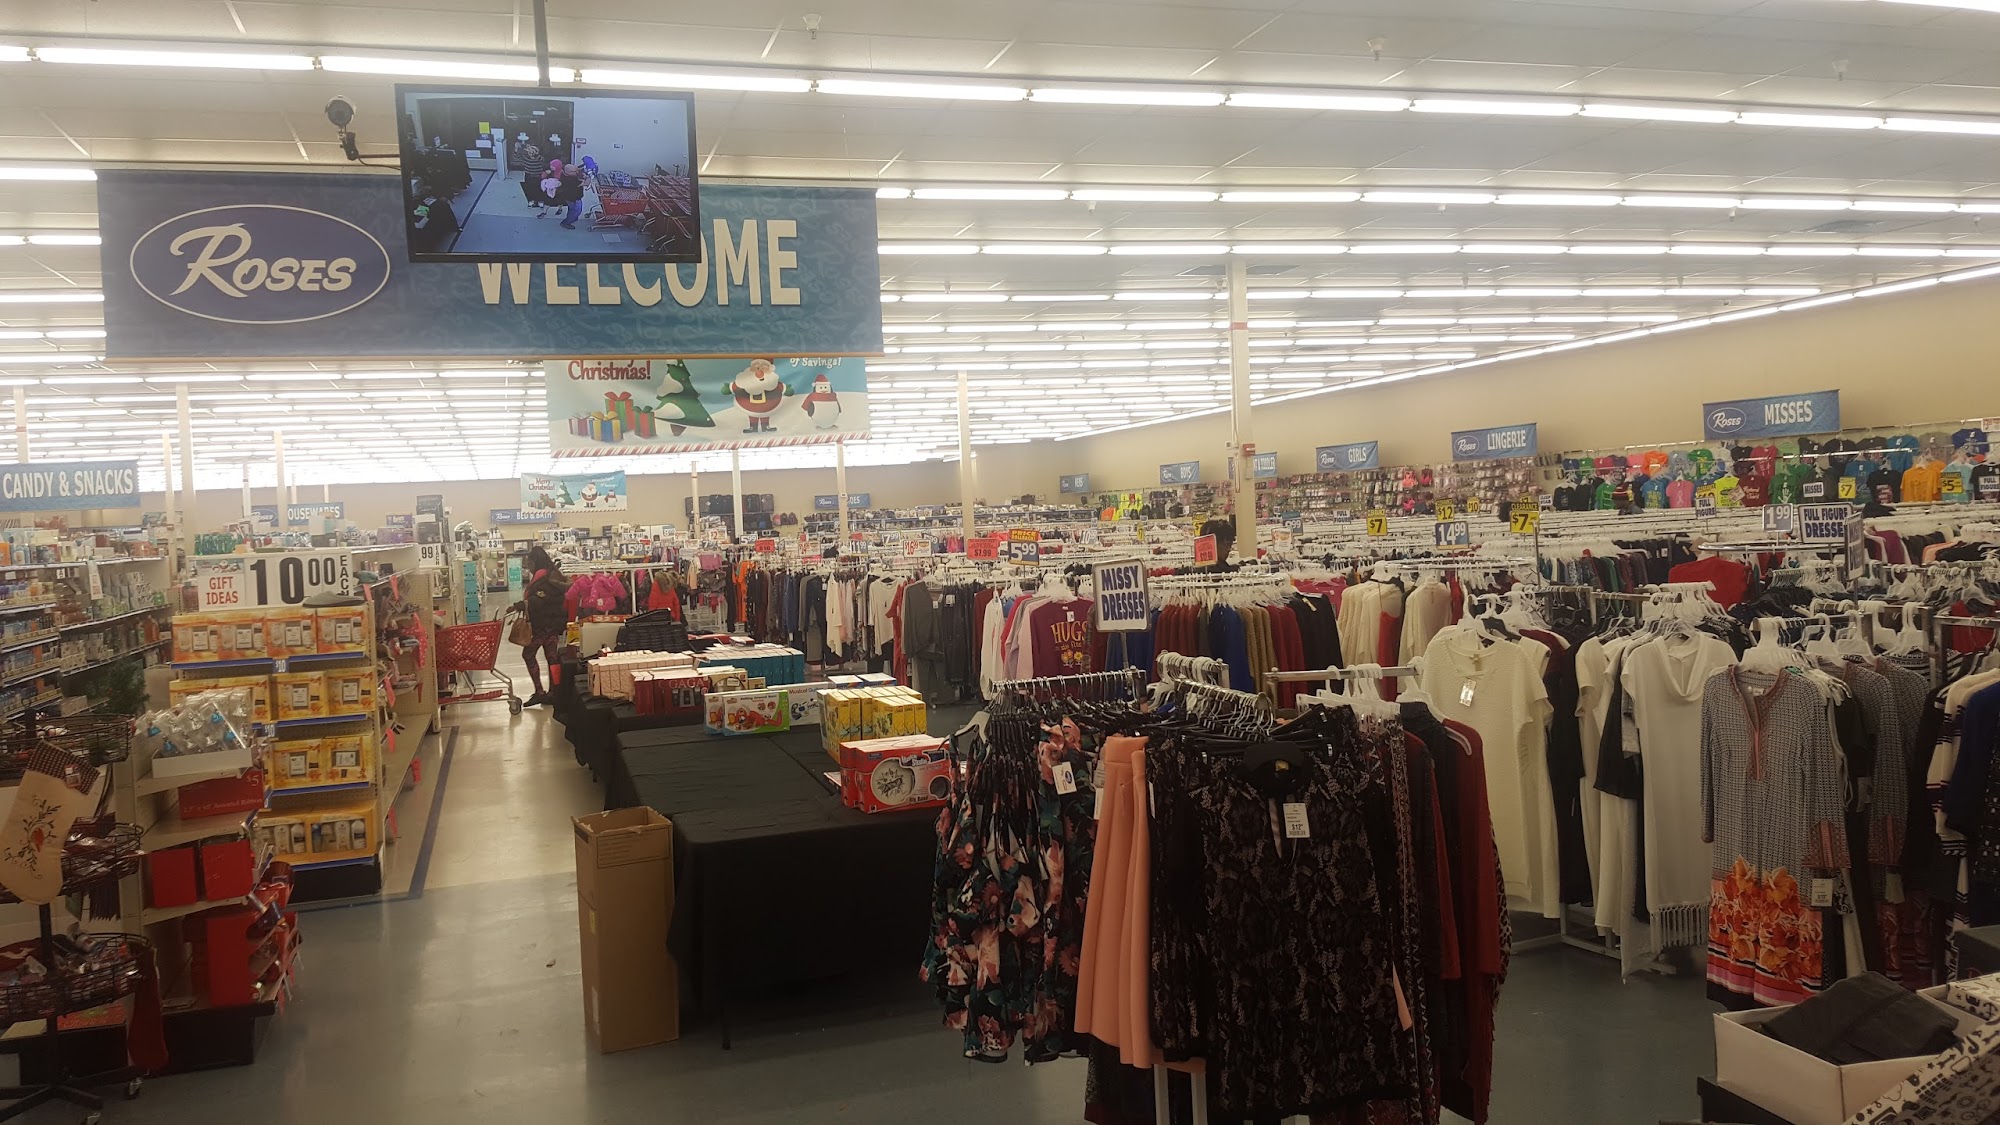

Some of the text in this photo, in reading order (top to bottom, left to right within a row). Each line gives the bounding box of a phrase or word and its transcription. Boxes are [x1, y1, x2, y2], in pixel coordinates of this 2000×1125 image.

[567, 359, 651, 381] Christmas!
[801, 357, 842, 369] Savings!
[1764, 400, 1813, 426] MISSES
[1487, 430, 1527, 451] LINGERIE
[1347, 447, 1367, 463] GIRLS
[1180, 466, 1192, 479] BOYS
[2, 468, 134, 499] CANDY & SNACKS
[1804, 484, 1823, 495] MISSES
[1698, 499, 1711, 507] FULL
[1695, 508, 1716, 517] FIGURE
[1803, 507, 1848, 521] FULL FIGURE
[1369, 518, 1383, 534] $7
[1512, 513, 1529, 531] $7
[1804, 521, 1845, 538] DRESSE
[209, 576, 234, 590] GIFT
[1101, 565, 1139, 591] MISSY
[206, 590, 239, 605] IDEAS
[1102, 590, 1145, 622] DRESSES
[1050, 620, 1088, 644] HUGS
[275, 659, 286, 673] $10
[668, 678, 705, 689] GAGA
[788, 687, 808, 695] Musical
[264, 724, 275, 738] $10
[246, 774, 260, 787] $5
